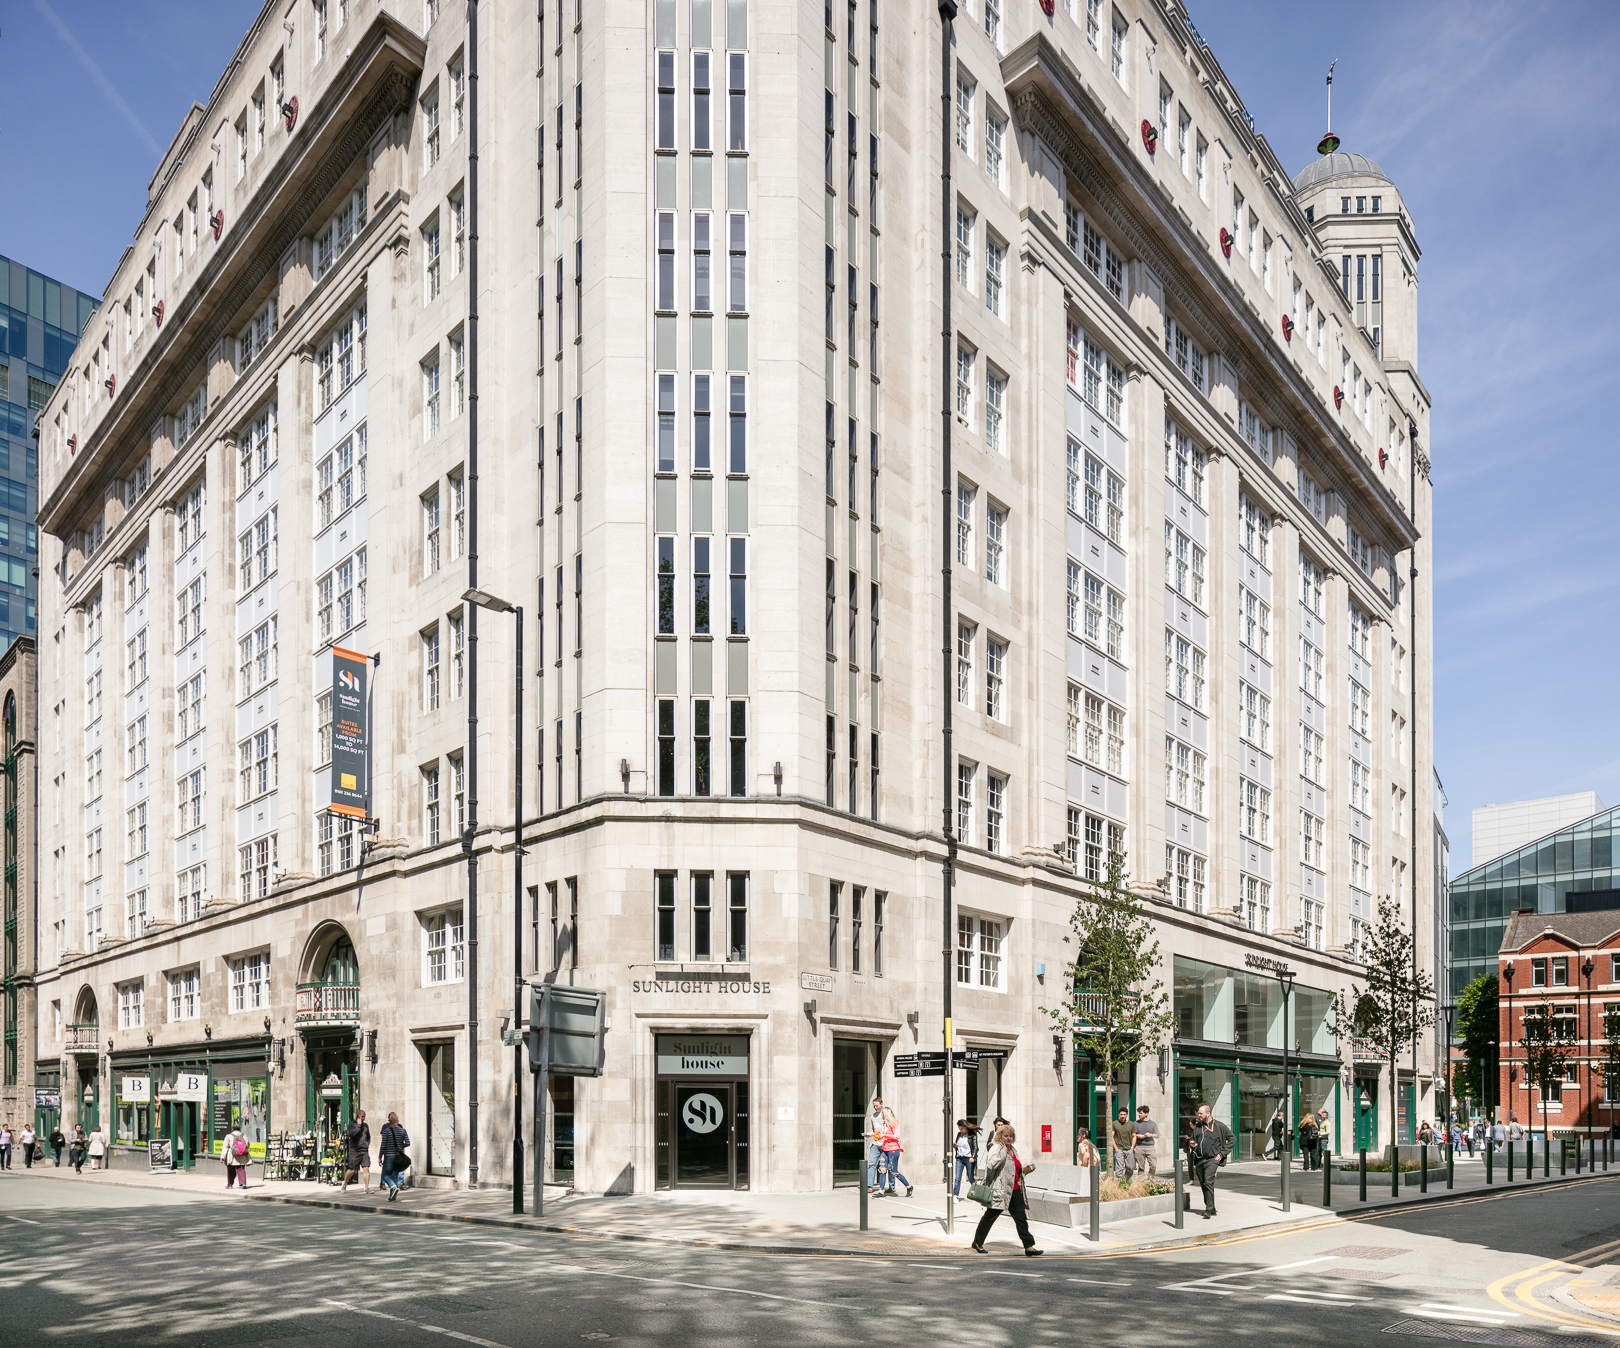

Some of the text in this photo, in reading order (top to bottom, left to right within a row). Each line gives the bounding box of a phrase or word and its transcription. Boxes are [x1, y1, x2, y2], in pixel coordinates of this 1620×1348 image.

[336, 723, 362, 734] AVAILABLE
[341, 719, 358, 728] SUITES
[335, 733, 349, 741] 1,000
[341, 730, 357, 738] FROM
[350, 747, 358, 755] SQ
[802, 974, 832, 984] LITTLE QUAY
[632, 980, 772, 994] SUNLIGHT HOUSE
[808, 981, 826, 989] STREET
[673, 1041, 733, 1058] Sunlight
[681, 1056, 725, 1069] house
[132, 1079, 142, 1091] B
[187, 1077, 199, 1090] B
